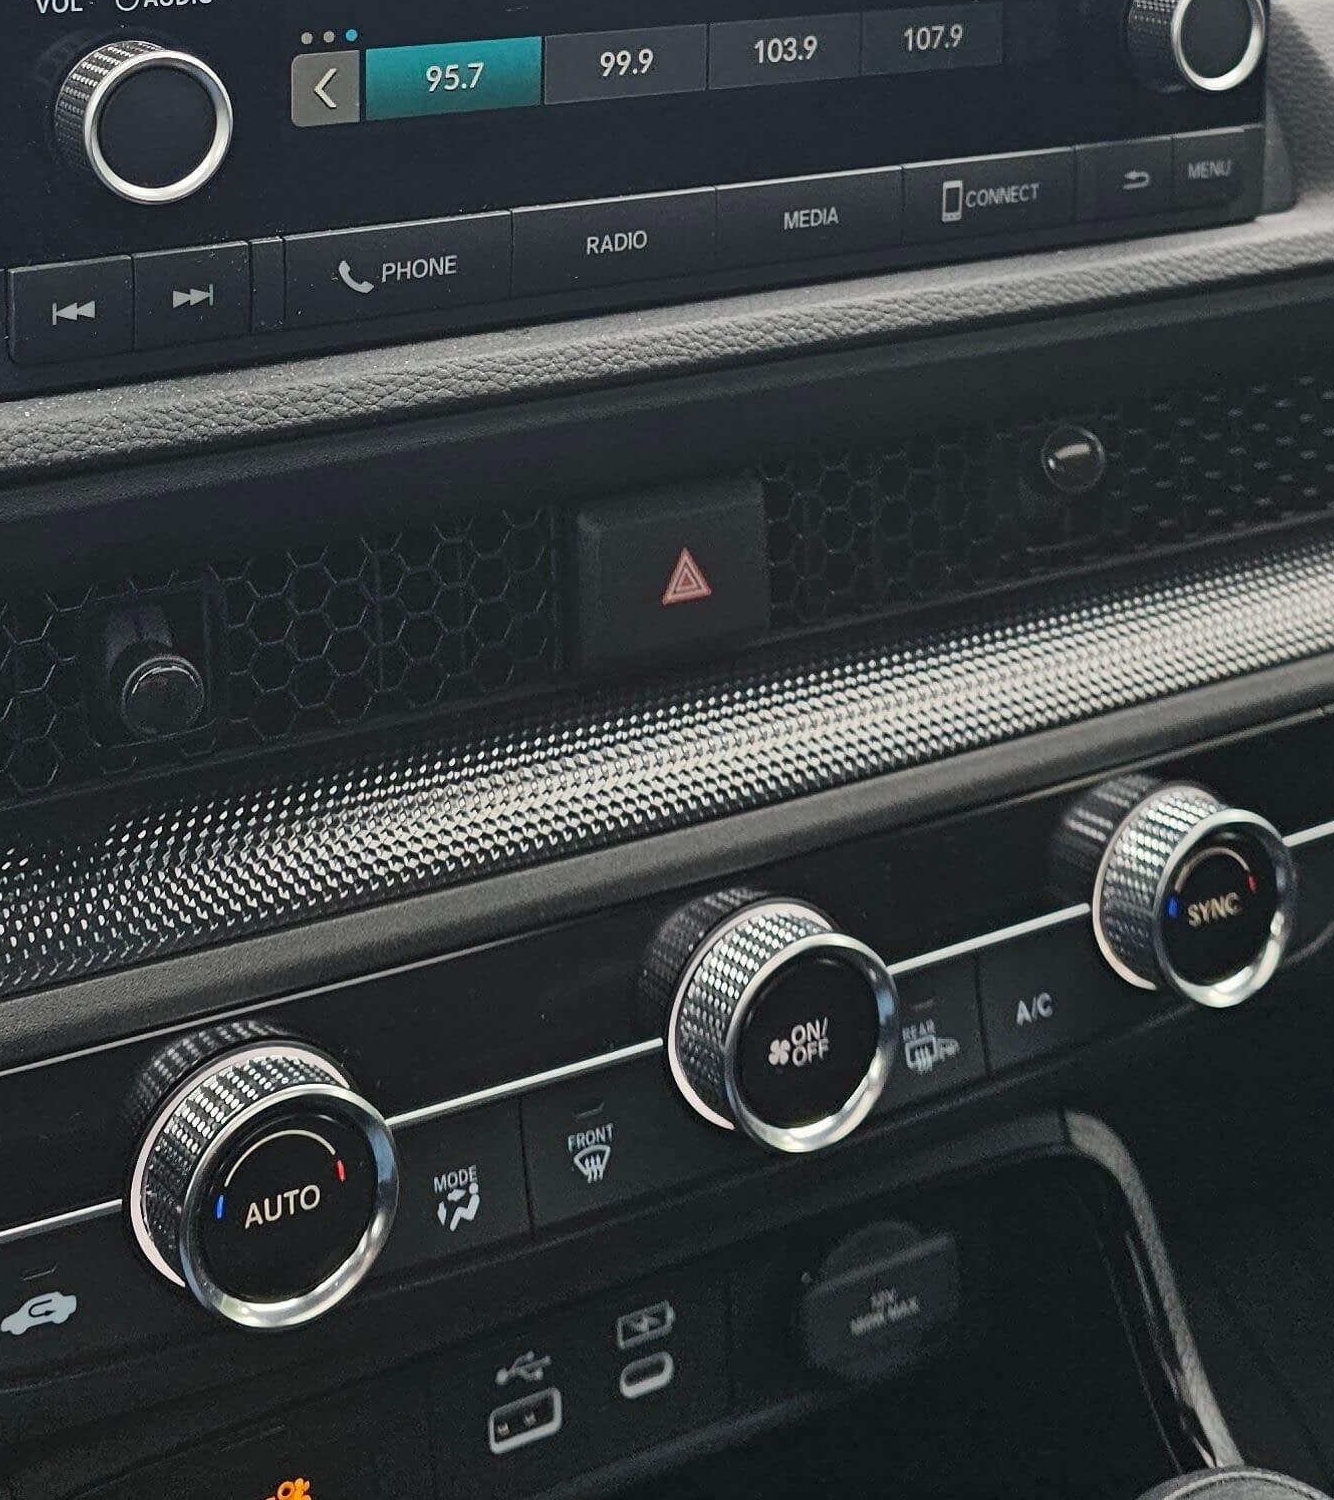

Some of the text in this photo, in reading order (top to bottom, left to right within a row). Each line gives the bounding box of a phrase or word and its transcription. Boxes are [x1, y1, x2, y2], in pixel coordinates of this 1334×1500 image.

[754, 35, 818, 63] 103.9
[903, 23, 963, 52] 107.9
[600, 48, 654, 77] 99.9
[425, 61, 485, 93] 95.7
[1187, 159, 1233, 181] MENU
[965, 183, 1040, 209] CONNECT
[783, 206, 839, 231] MEDIA
[586, 230, 648, 255] RADIO
[381, 255, 458, 283] PHONE
[1187, 891, 1240, 928] SYNC
[1015, 992, 1054, 1025] A/C
[790, 1017, 829, 1045] ON/
[791, 1037, 830, 1067] OFF
[568, 1124, 614, 1151] FRONT
[433, 1164, 478, 1194] MODE
[244, 1184, 321, 1229] AUTO
